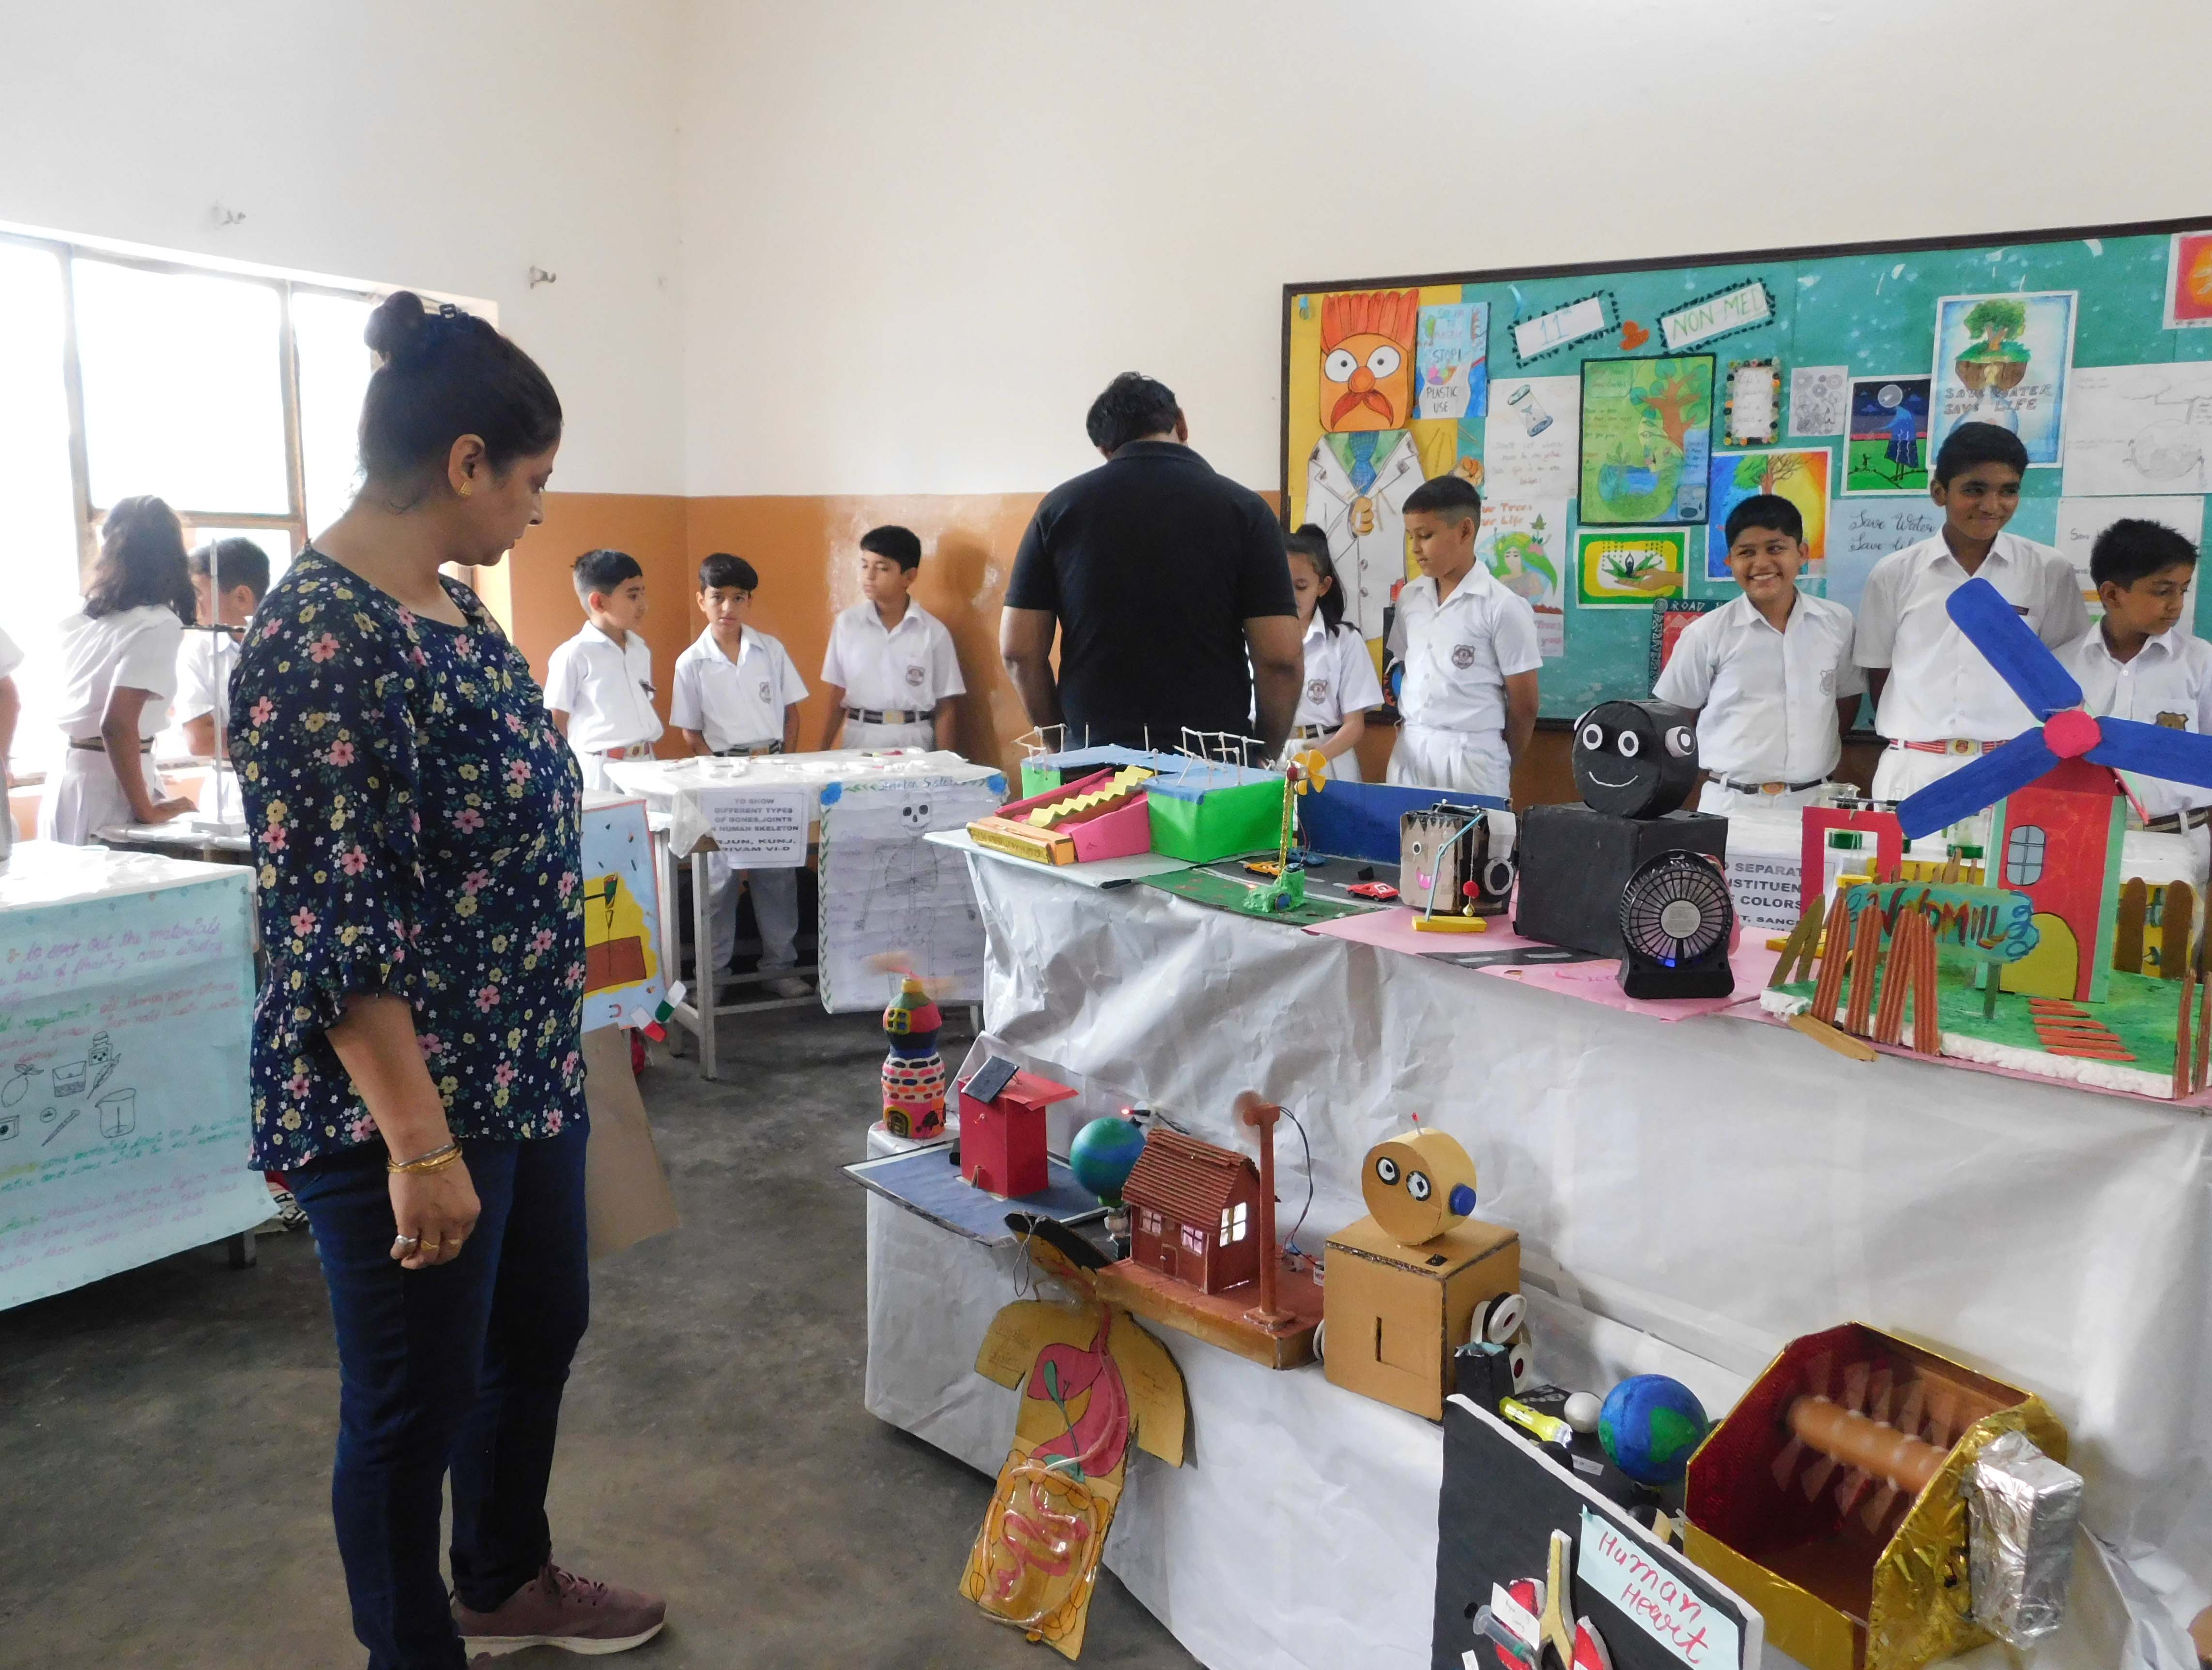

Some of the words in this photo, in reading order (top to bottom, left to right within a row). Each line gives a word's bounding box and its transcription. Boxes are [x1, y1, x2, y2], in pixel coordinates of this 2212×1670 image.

[1426, 386, 1458, 399] PLASTIC
[1433, 401, 1449, 413] USE
[1994, 398, 2038, 412] LIFE
[1848, 510, 1885, 530] Save
[1891, 512, 1936, 532] Water
[1848, 532, 1883, 552] Save
[1670, 601, 1705, 612] ROAD
[1735, 863, 1802, 877] SEPARAT
[1756, 916, 1798, 926] SANC
[1599, 1531, 1702, 1624] Human
[1620, 1582, 1709, 1664] Heart
